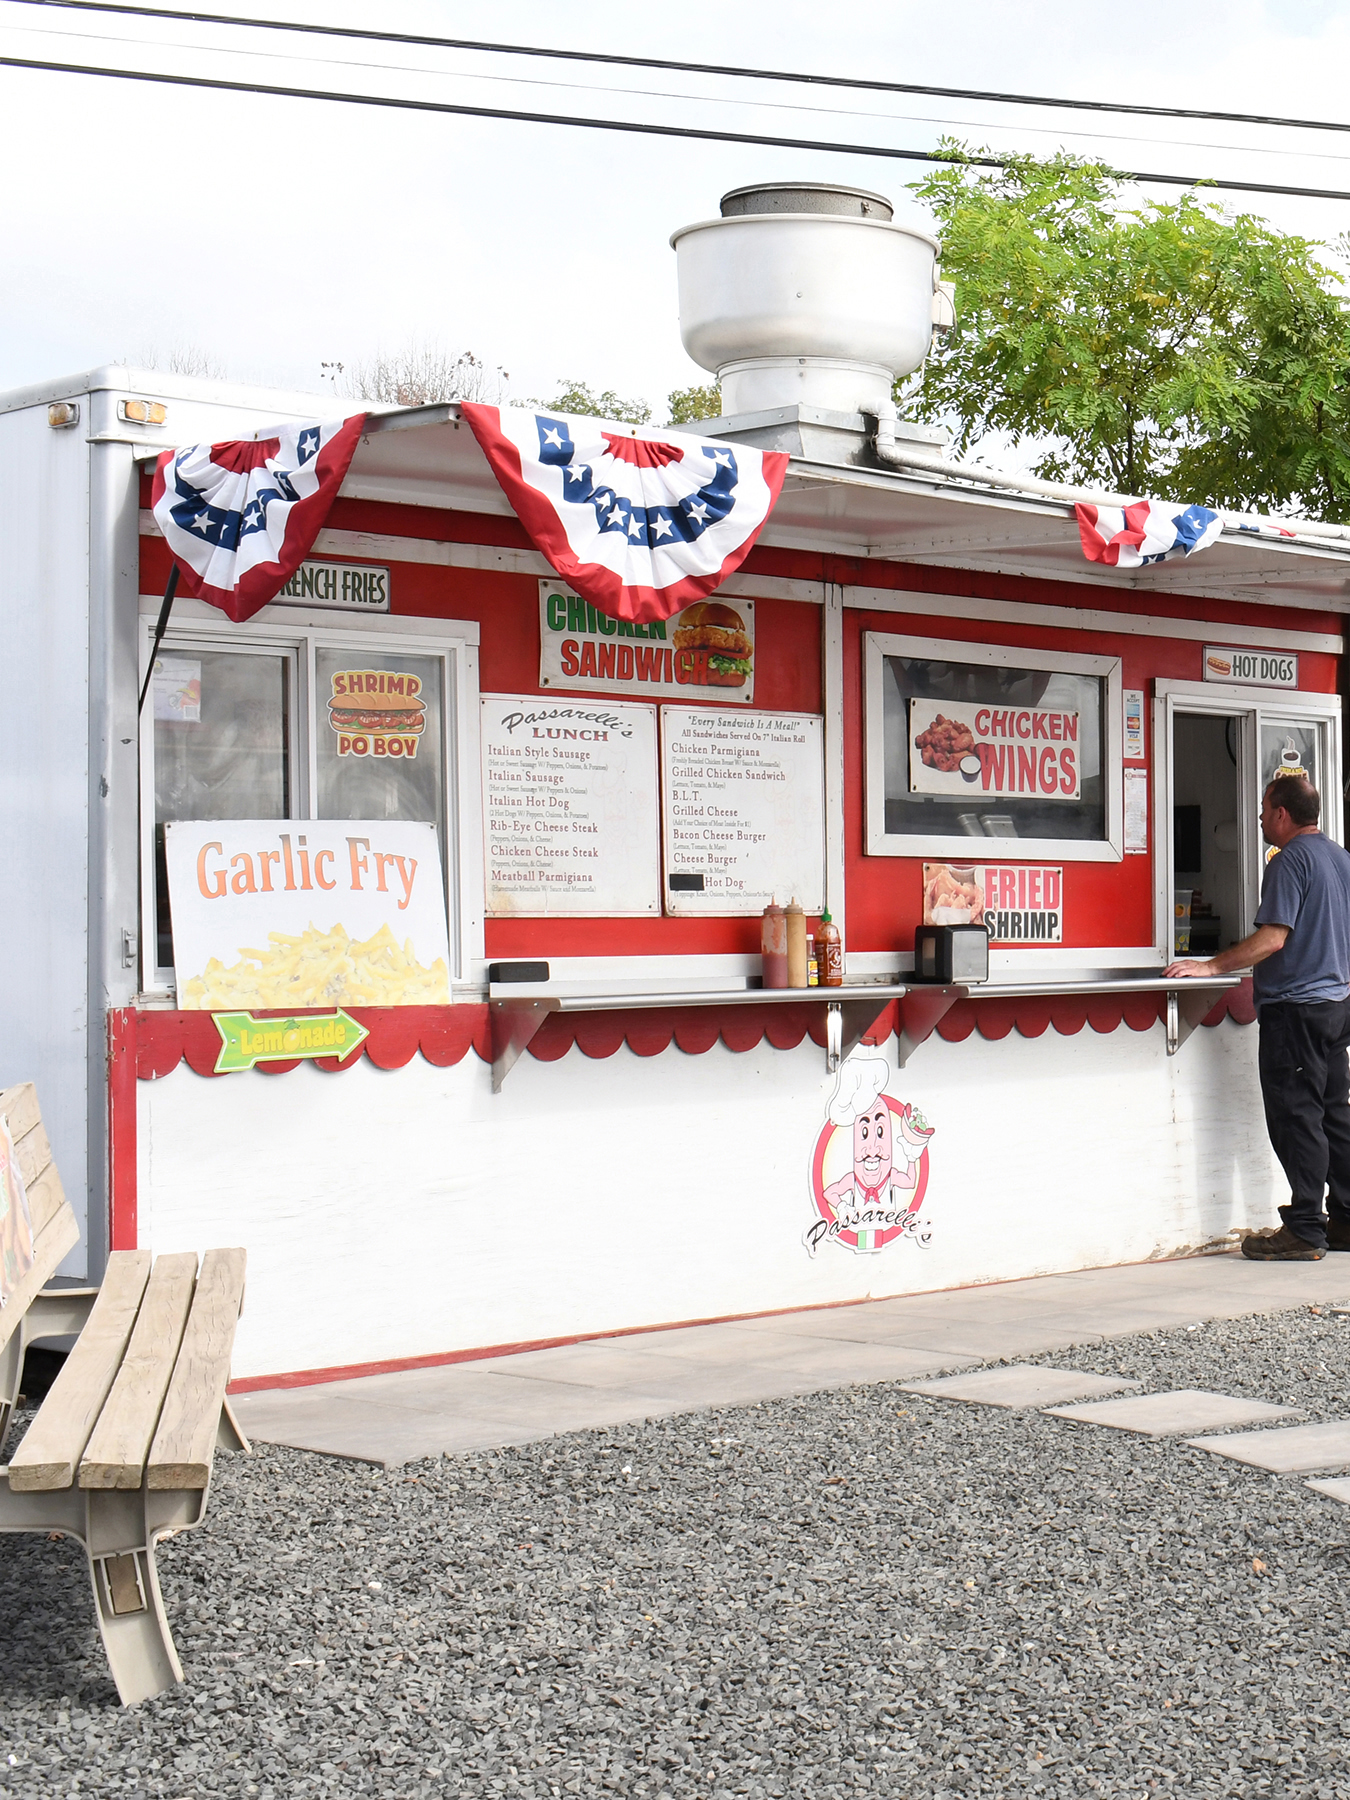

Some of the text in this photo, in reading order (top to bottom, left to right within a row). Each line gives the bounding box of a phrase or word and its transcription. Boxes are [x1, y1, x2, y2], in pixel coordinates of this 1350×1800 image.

[342, 571, 386, 604] FRIES
[560, 639, 708, 686] SANDWICH
[1232, 654, 1293, 682] HOT DOGS
[333, 672, 421, 698] SHRIMP
[501, 708, 633, 739] Passarelli's
[717, 717, 755, 729] Sandwich
[757, 719, 764, 729] Is
[766, 720, 773, 730] A
[975, 708, 1078, 742] CHICKEN
[532, 727, 609, 742] LUNCH
[681, 729, 691, 738] All
[339, 735, 418, 757] PO BOY
[488, 744, 591, 763] Italian Style Sausage
[671, 742, 760, 758] Chicken Parmigiana
[488, 769, 564, 785] Italian Sausage
[672, 766, 786, 781] Grilled Chicken Sandwich
[978, 744, 1077, 795] WINGS
[489, 795, 570, 810] Italian Hot Dog
[672, 790, 703, 801] B.L.T.
[672, 804, 738, 817] Grilled Cheese
[490, 820, 599, 834] Rib-Eye Cheese Steak
[673, 829, 766, 844] Bacon Cheese Burger
[491, 845, 599, 858] Chicken Cheese Steak
[673, 853, 737, 866] Cheese Burger
[196, 834, 418, 910] Garlic Fry
[491, 870, 593, 884] Meatball Parmigiana
[705, 877, 744, 890] Hot Dog
[984, 868, 1060, 910] FRIED
[984, 910, 1058, 940] SHRIMP
[240, 1020, 346, 1055] Lemonade
[807, 1207, 932, 1251] Passarelli's
